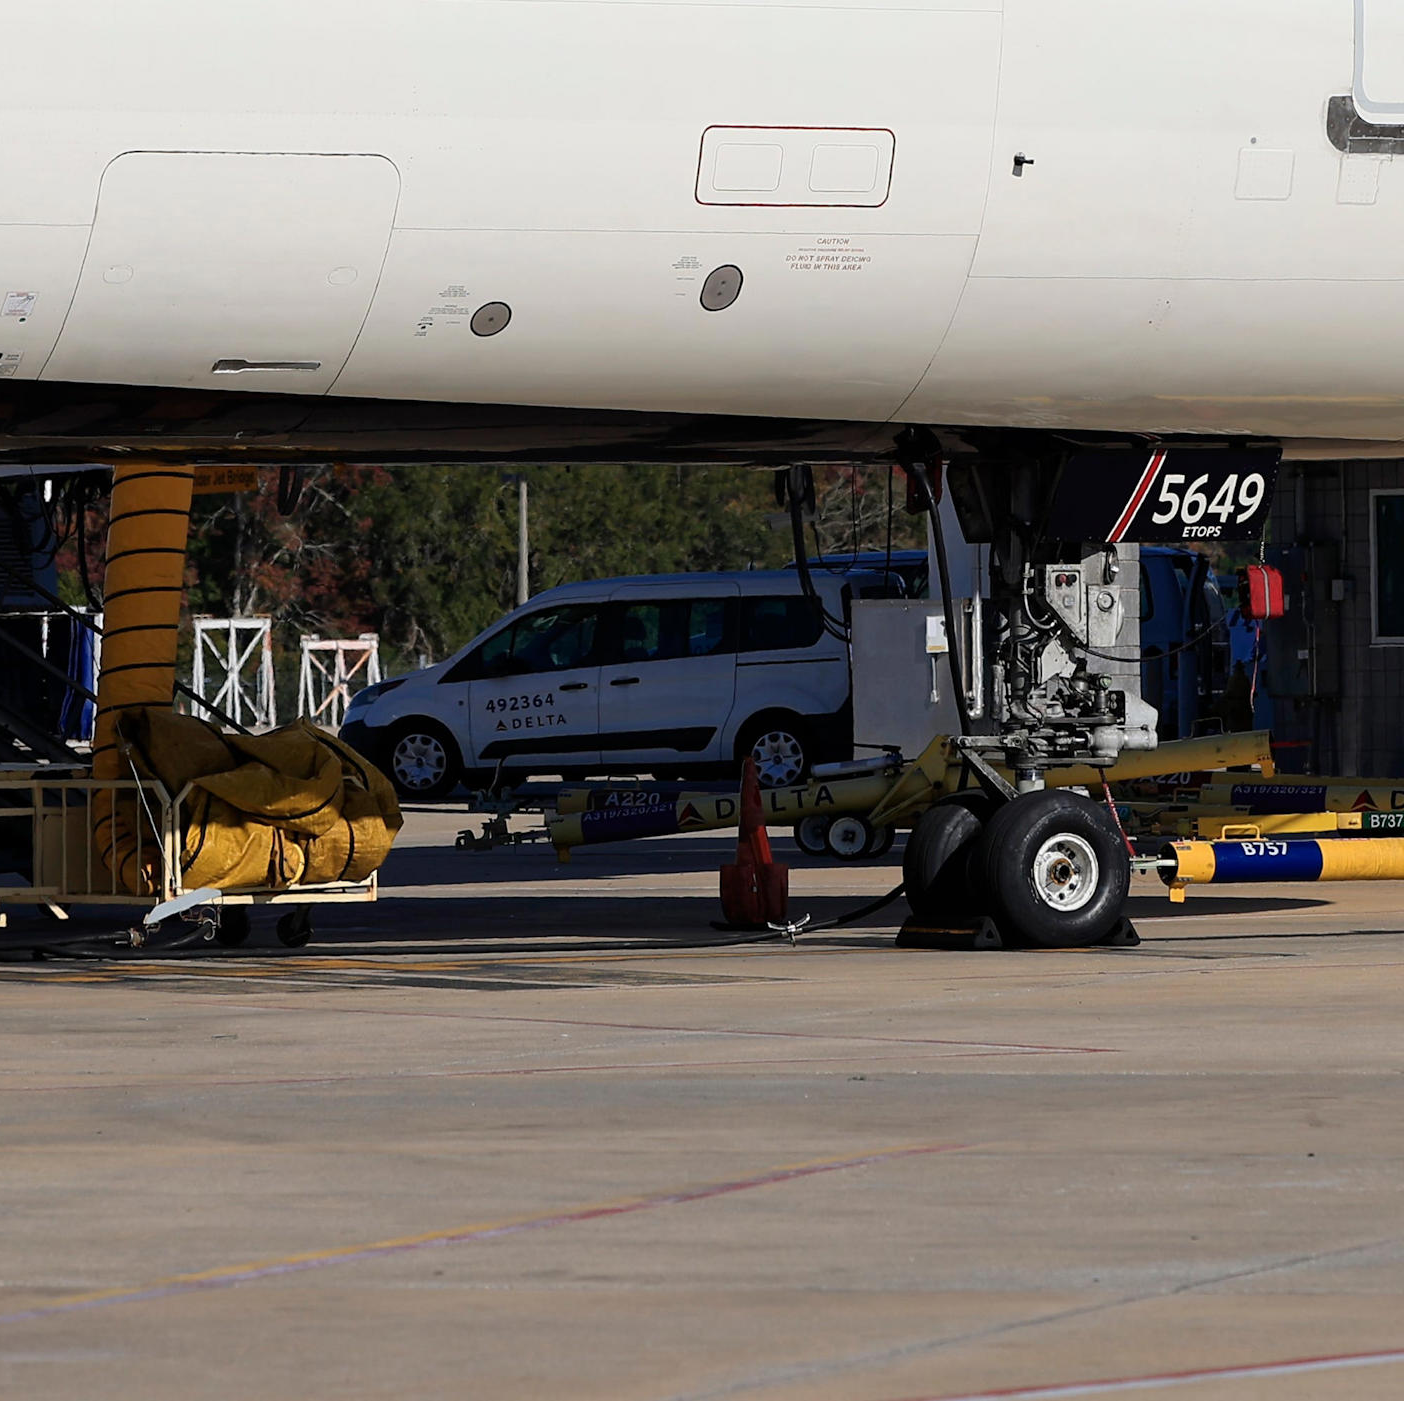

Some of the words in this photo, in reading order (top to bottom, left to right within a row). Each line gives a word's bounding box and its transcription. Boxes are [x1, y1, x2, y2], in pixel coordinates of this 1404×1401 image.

[1151, 472, 1265, 525] 5649
[1182, 526, 1222, 538] ETOPS
[486, 693, 554, 713] 492364
[512, 714, 566, 729] DELTA
[716, 785, 834, 820] DLTA
[1370, 814, 1404, 828] B737
[1241, 842, 1288, 856] B757
